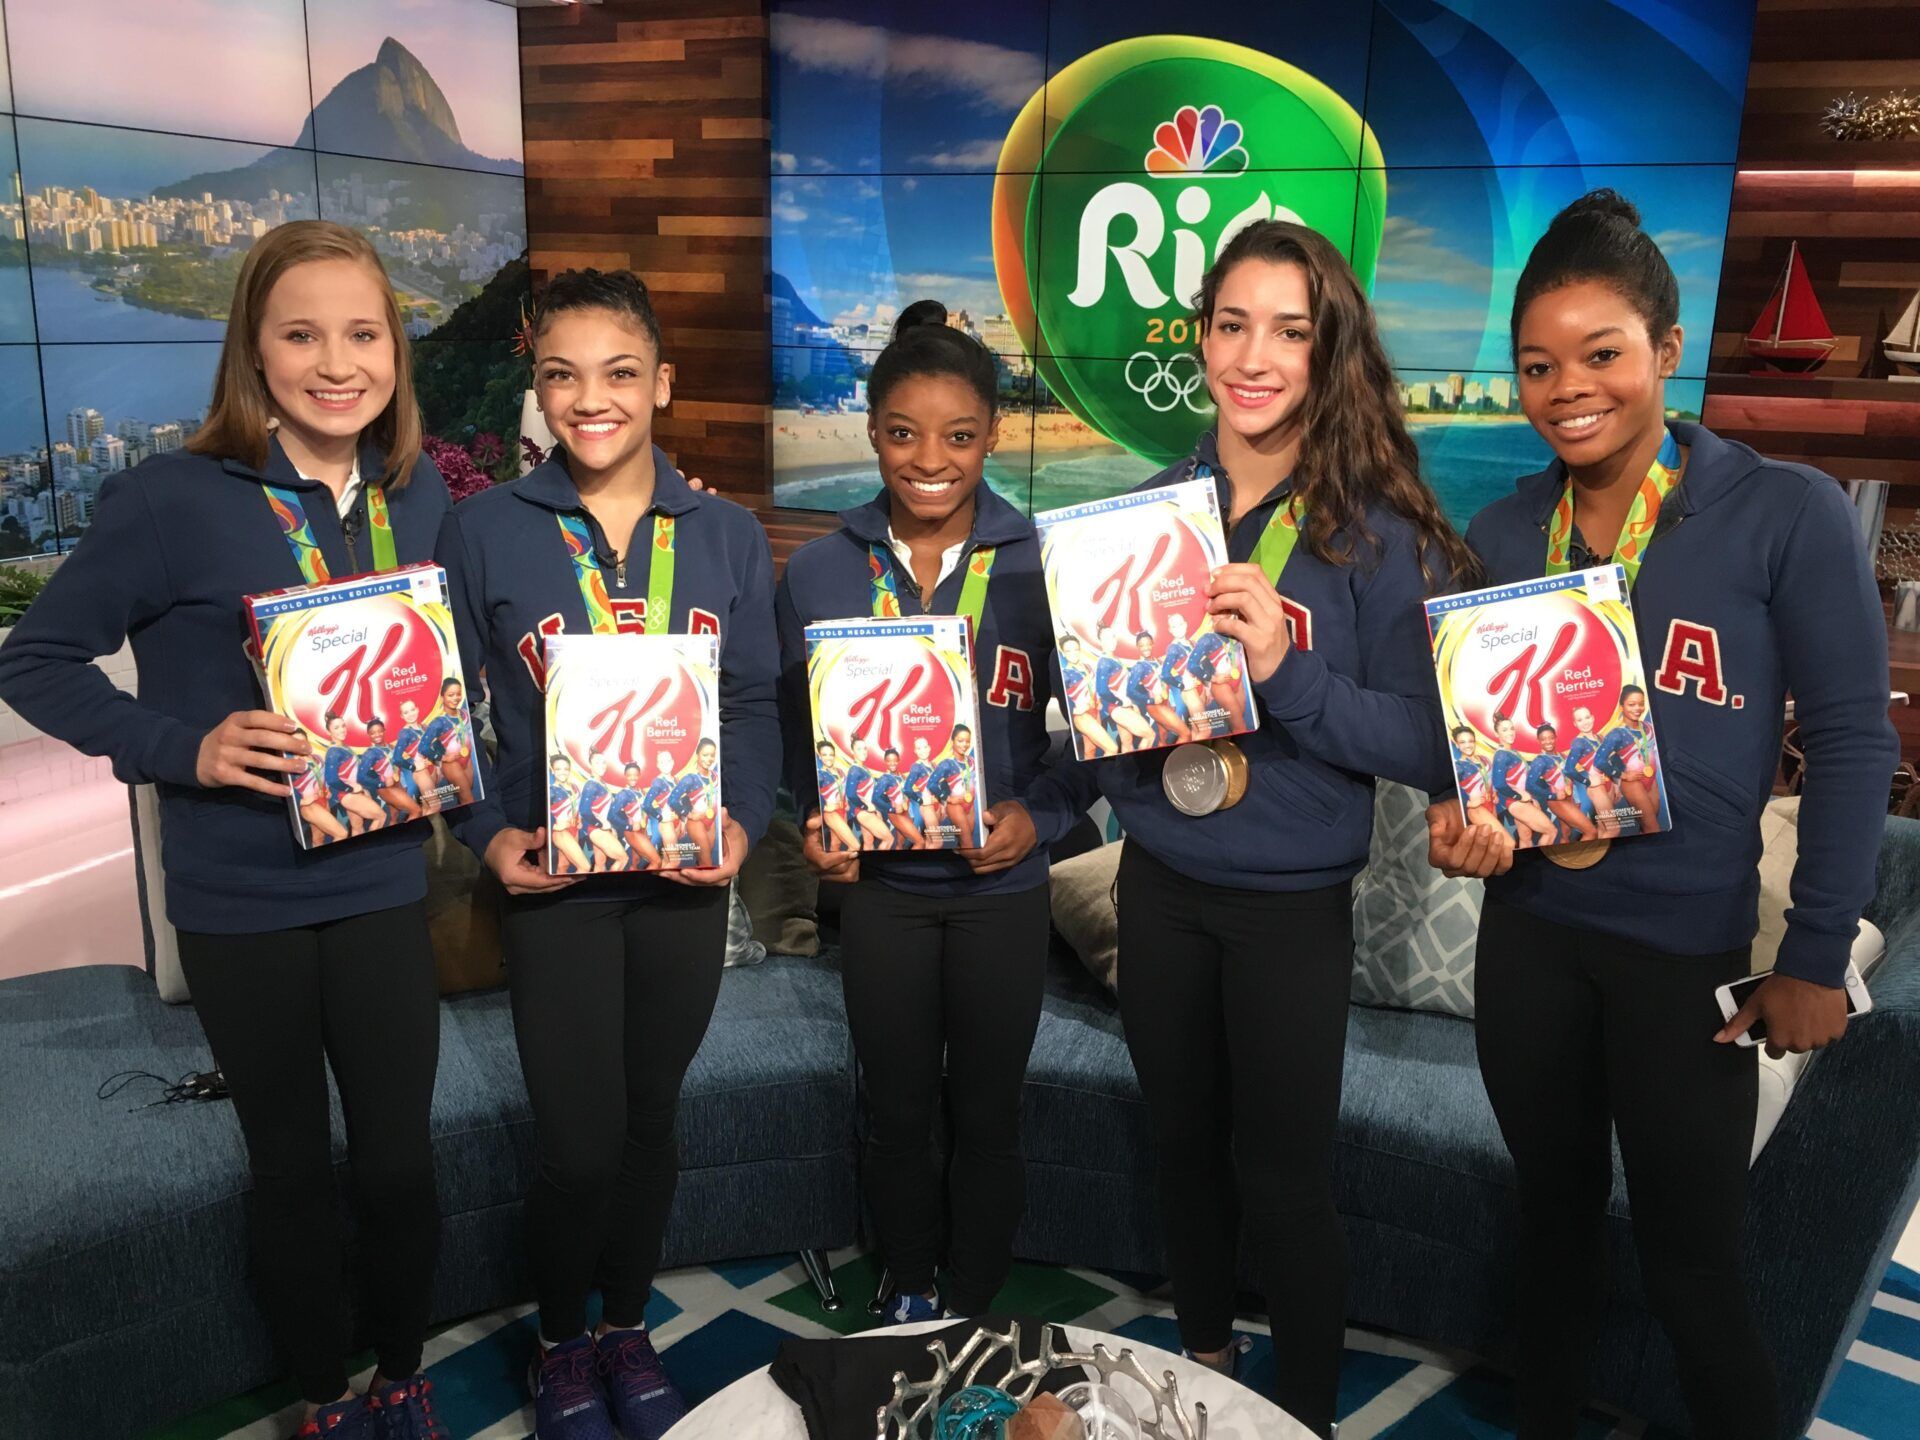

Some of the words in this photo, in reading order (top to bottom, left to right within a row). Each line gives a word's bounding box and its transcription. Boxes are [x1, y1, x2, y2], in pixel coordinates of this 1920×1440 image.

[1146, 318, 1201, 344] 201
[1051, 510, 1077, 521] GOLD
[1081, 503, 1115, 515] MEDAL
[1118, 492, 1161, 506] EDITION
[1160, 573, 1184, 589] Red
[273, 601, 303, 612] GOLD
[308, 594, 344, 606] MEDAL
[349, 584, 393, 598] EDITION
[1152, 586, 1196, 602] Berries
[1444, 599, 1472, 610] GOLD
[1477, 591, 1513, 603] MEDAL
[1519, 580, 1566, 595] EDITION
[312, 626, 368, 653] Special
[1480, 625, 1538, 651] Special
[318, 622, 404, 724] K
[392, 662, 417, 678] Red
[846, 663, 894, 678] Special
[1487, 622, 1577, 729] K
[1563, 665, 1592, 681] Red
[384, 674, 428, 690] Berries
[1555, 678, 1605, 694] Berries
[848, 663, 924, 751] K
[910, 703, 932, 714] Red
[655, 716, 678, 727] Red
[903, 713, 941, 724] Berries
[646, 726, 687, 737] Berries
